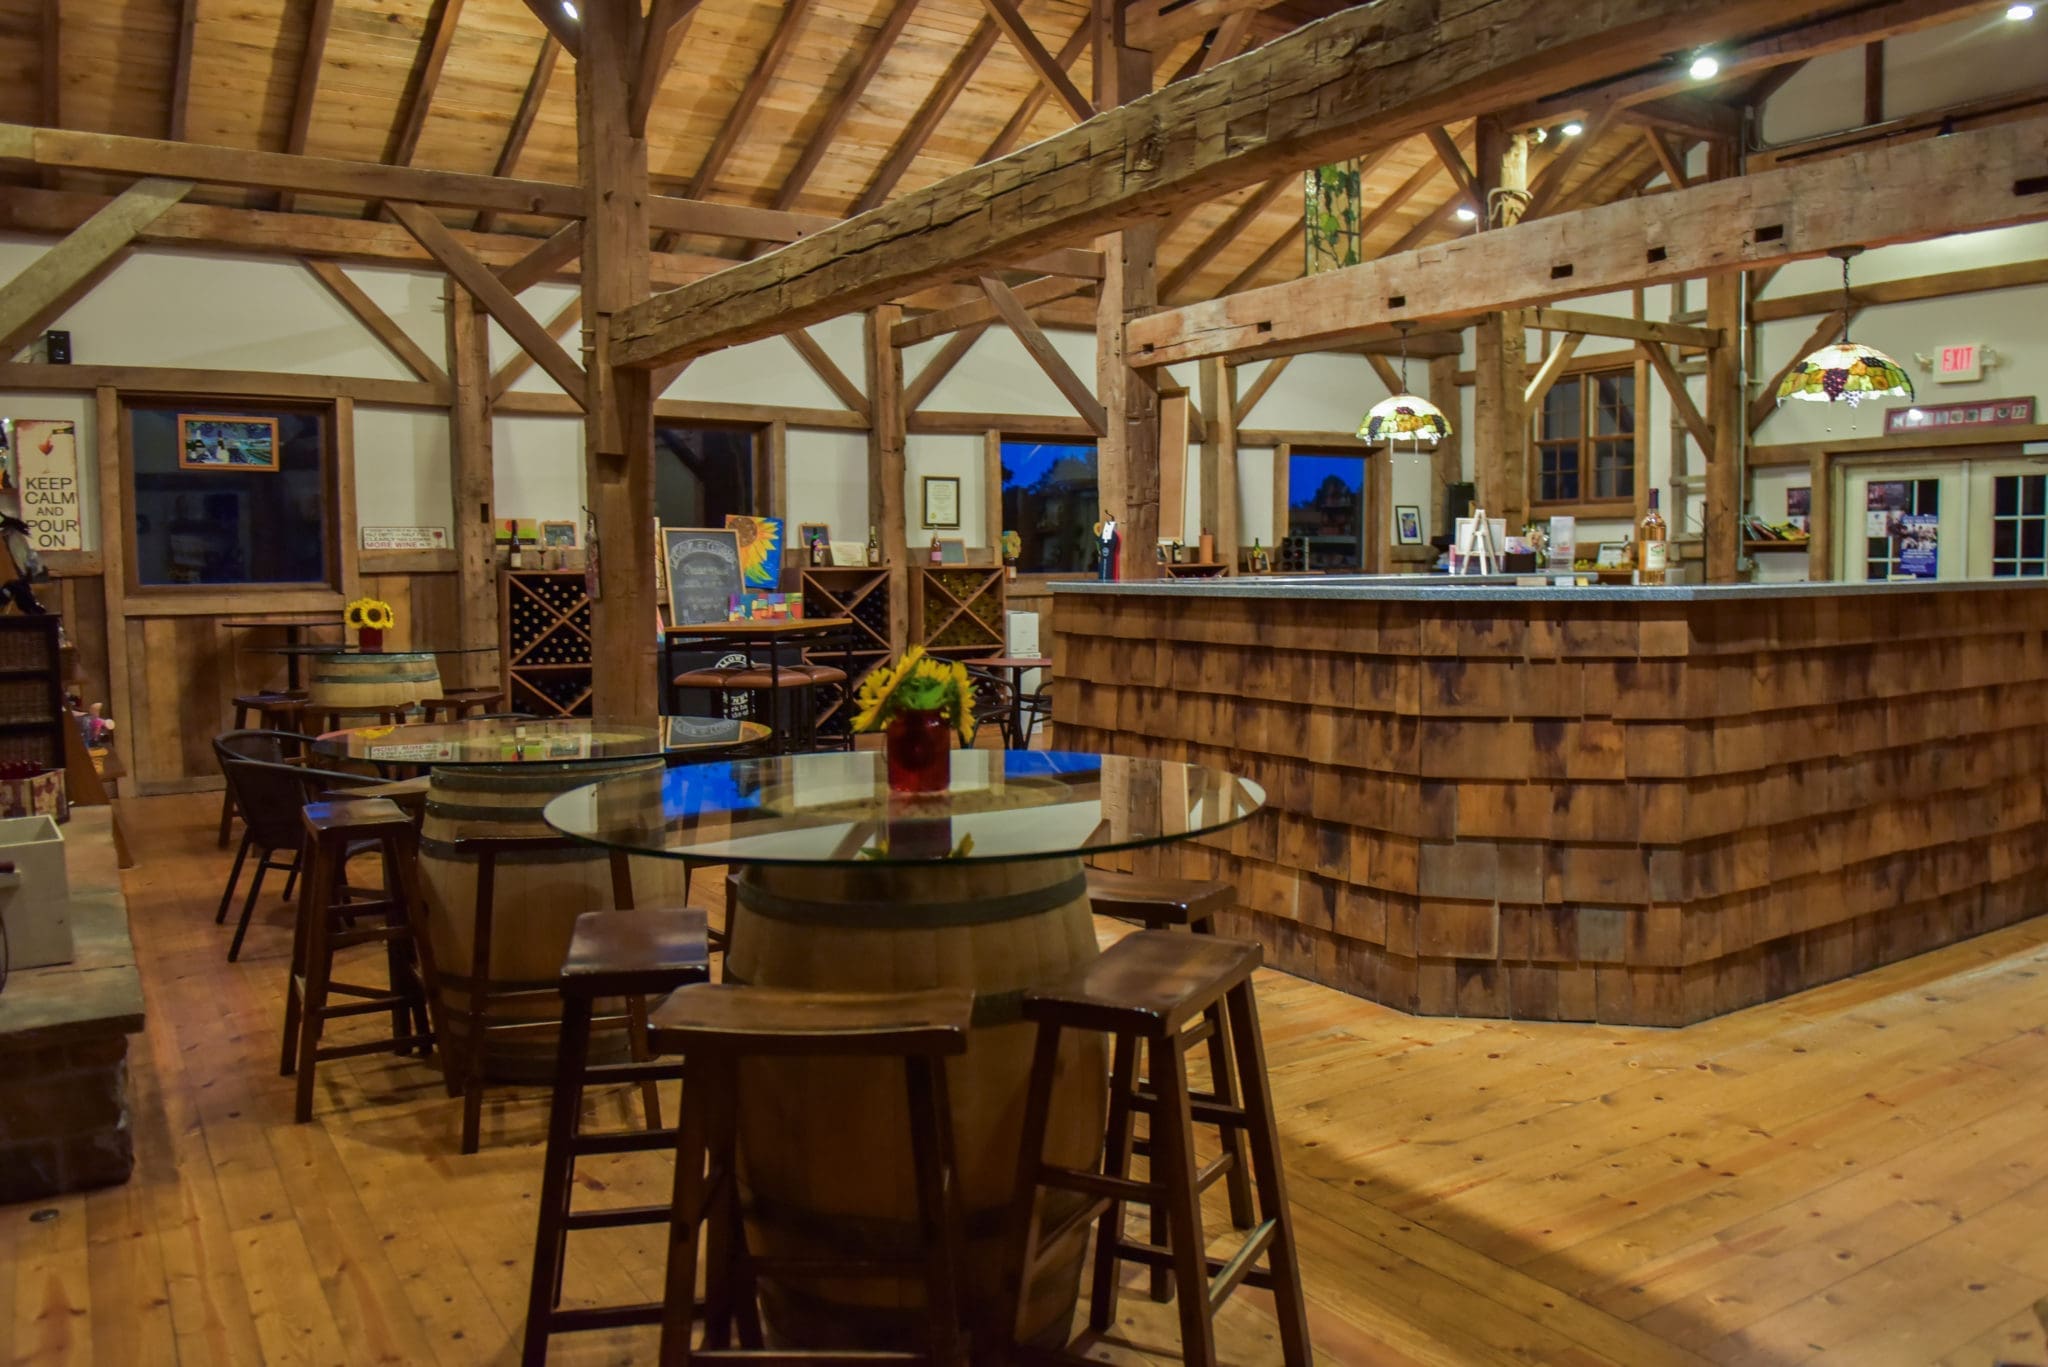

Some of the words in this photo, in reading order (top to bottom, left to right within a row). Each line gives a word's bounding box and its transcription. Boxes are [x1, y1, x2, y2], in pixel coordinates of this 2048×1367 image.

[1942, 347, 1973, 371] EXIT
[26, 477, 73, 490] KEEP
[25, 491, 76, 505] CALM
[36, 506, 64, 516] AND
[26, 519, 78, 532] POUR
[38, 534, 66, 547] ON
